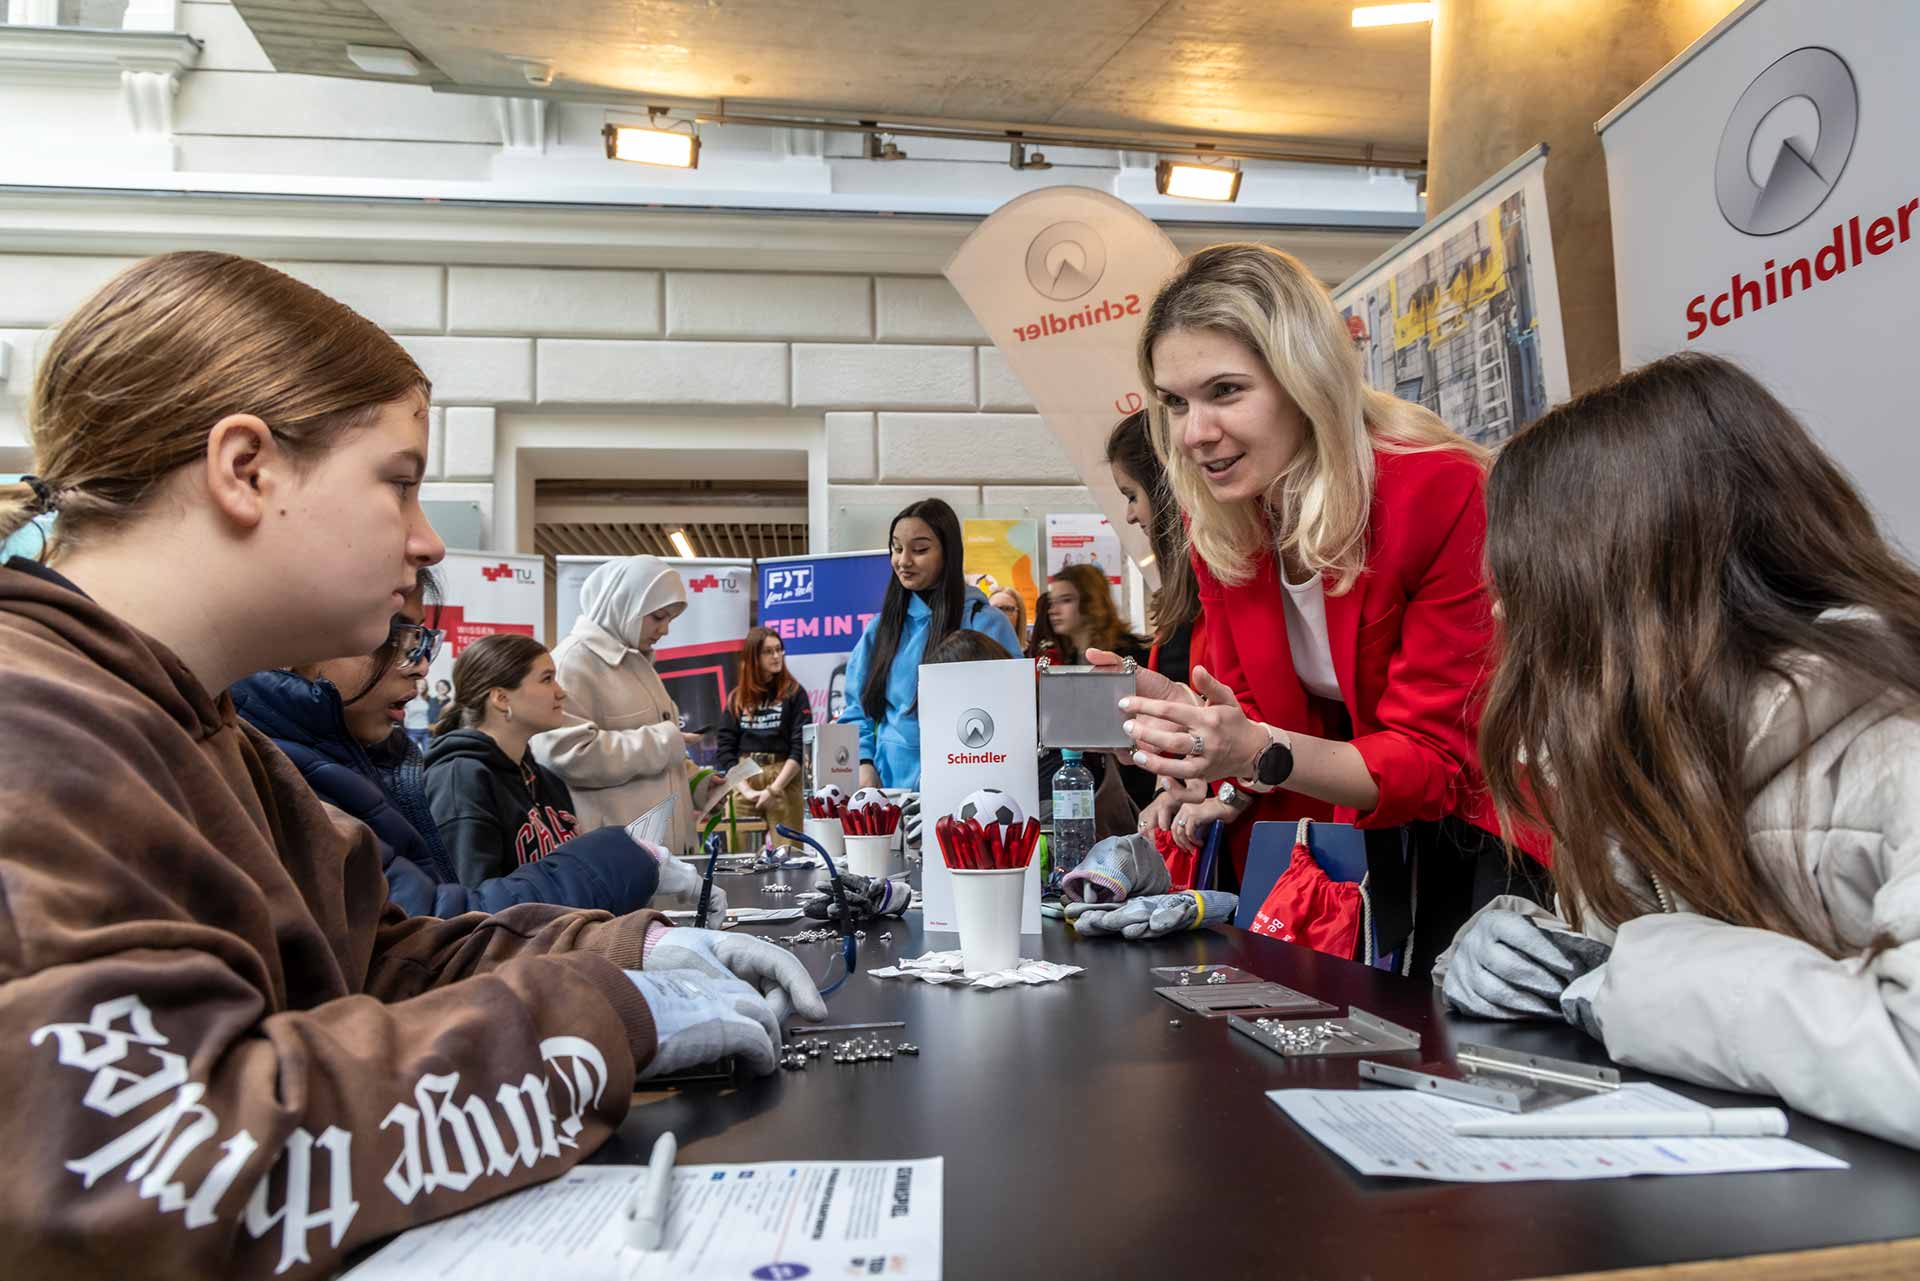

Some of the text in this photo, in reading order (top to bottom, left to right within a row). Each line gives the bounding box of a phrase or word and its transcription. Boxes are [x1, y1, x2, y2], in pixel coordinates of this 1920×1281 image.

[1685, 197, 1920, 341] Schindler
[513, 568, 532, 580] TU
[720, 578, 737, 590] TU
[824, 615, 853, 636] IN
[947, 752, 1007, 764] Schindler
